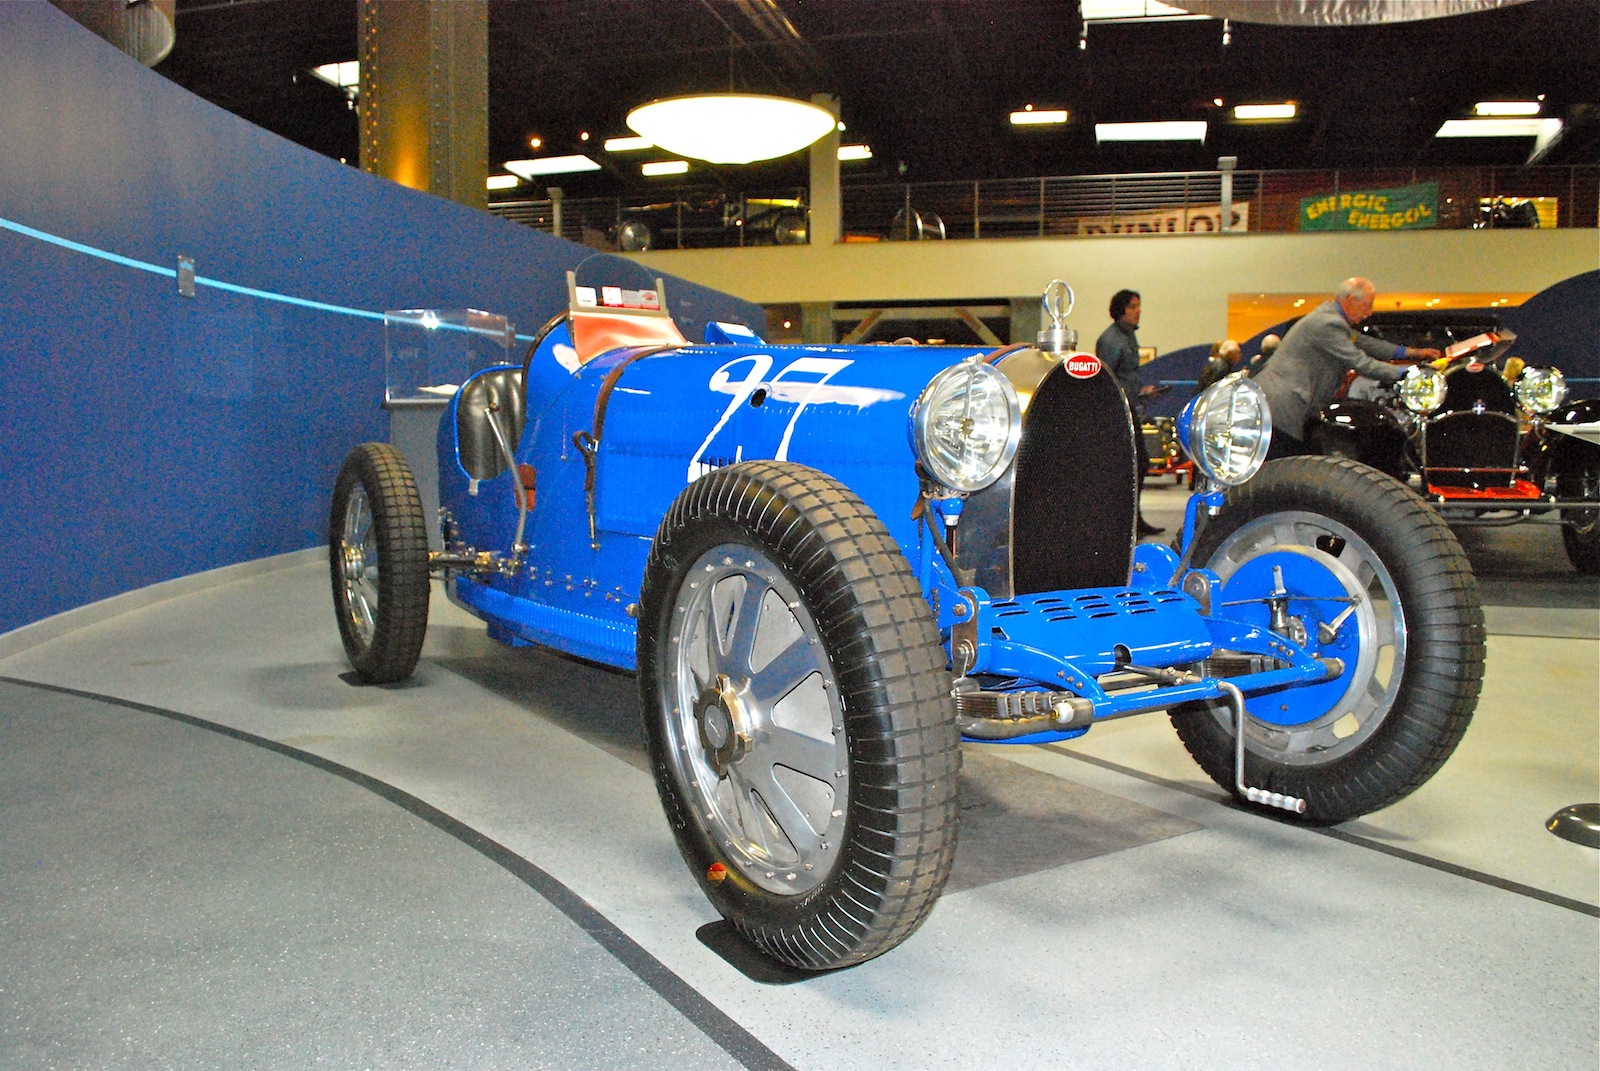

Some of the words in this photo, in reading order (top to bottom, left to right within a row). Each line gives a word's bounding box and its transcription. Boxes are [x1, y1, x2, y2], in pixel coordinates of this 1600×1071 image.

[1084, 211, 1240, 234] LOP
[1348, 203, 1432, 230] ENERGOL
[1068, 361, 1098, 372] BUGATTI
